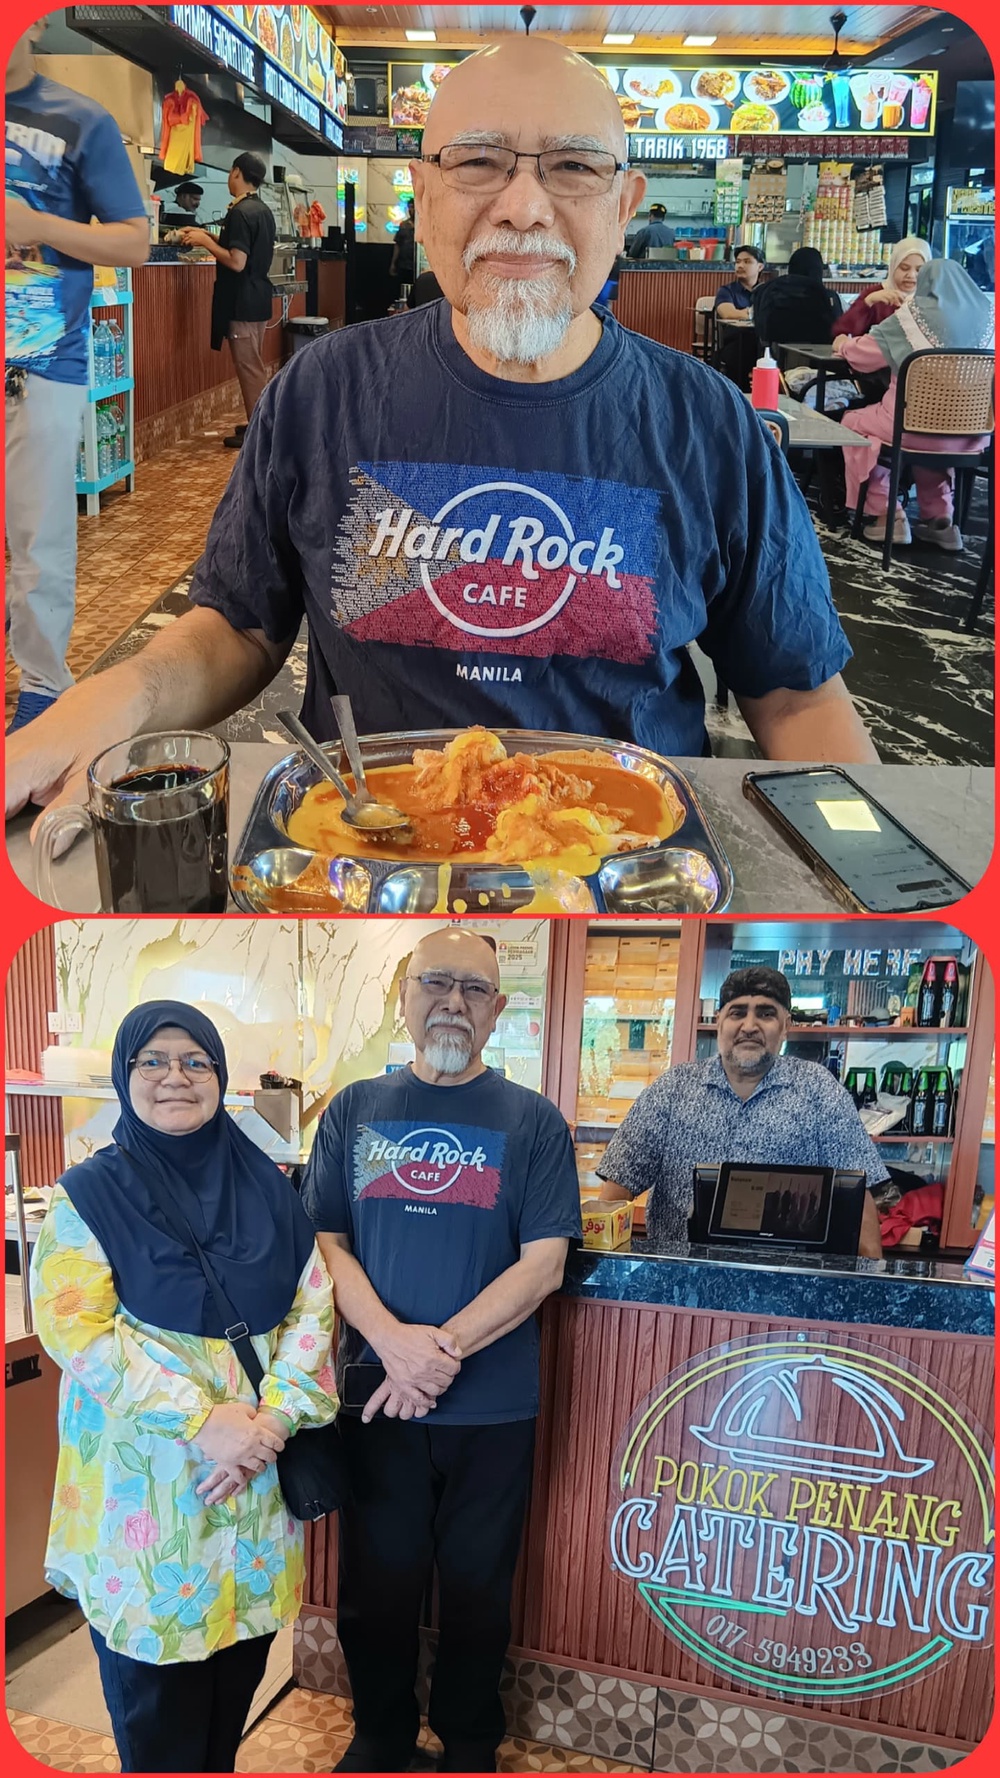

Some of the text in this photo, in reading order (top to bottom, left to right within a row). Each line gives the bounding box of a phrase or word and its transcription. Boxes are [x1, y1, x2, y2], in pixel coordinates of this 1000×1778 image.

[635, 137, 684, 159] TARIK
[691, 137, 728, 159] 1968
[368, 509, 624, 589] Hard Rock
[463, 583, 527, 608] CAFE
[456, 663, 522, 682] MANILA
[777, 949, 833, 976] PAY
[367, 1140, 487, 1172] Hard Rock
[410, 1169, 441, 1182] CAFE
[404, 1204, 438, 1215] MANILA
[651, 1455, 963, 1547] POKOK PENANG
[610, 1497, 995, 1641] CATERING
[705, 1614, 873, 1675] 017-5949233
